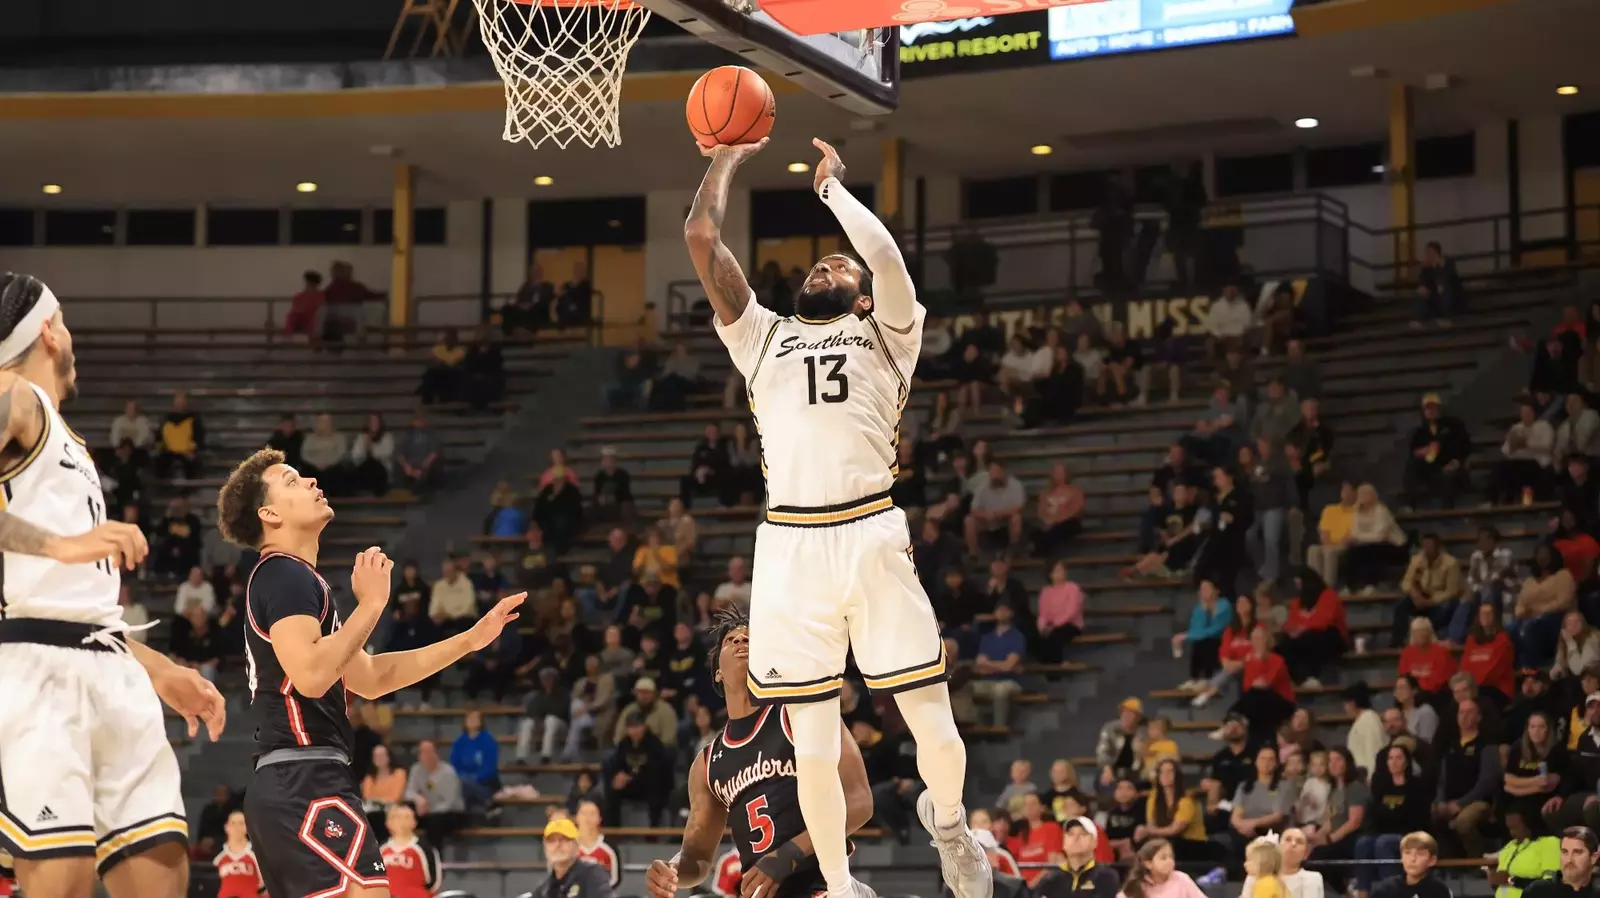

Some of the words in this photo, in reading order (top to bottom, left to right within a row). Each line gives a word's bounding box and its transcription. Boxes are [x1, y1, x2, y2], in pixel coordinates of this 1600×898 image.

[957, 31, 1041, 57] RESORT
[1128, 296, 1211, 340] MISS
[775, 330, 875, 358] Southern
[804, 354, 849, 405] 13
[714, 751, 797, 806] Crusaders
[746, 794, 775, 853] 5
